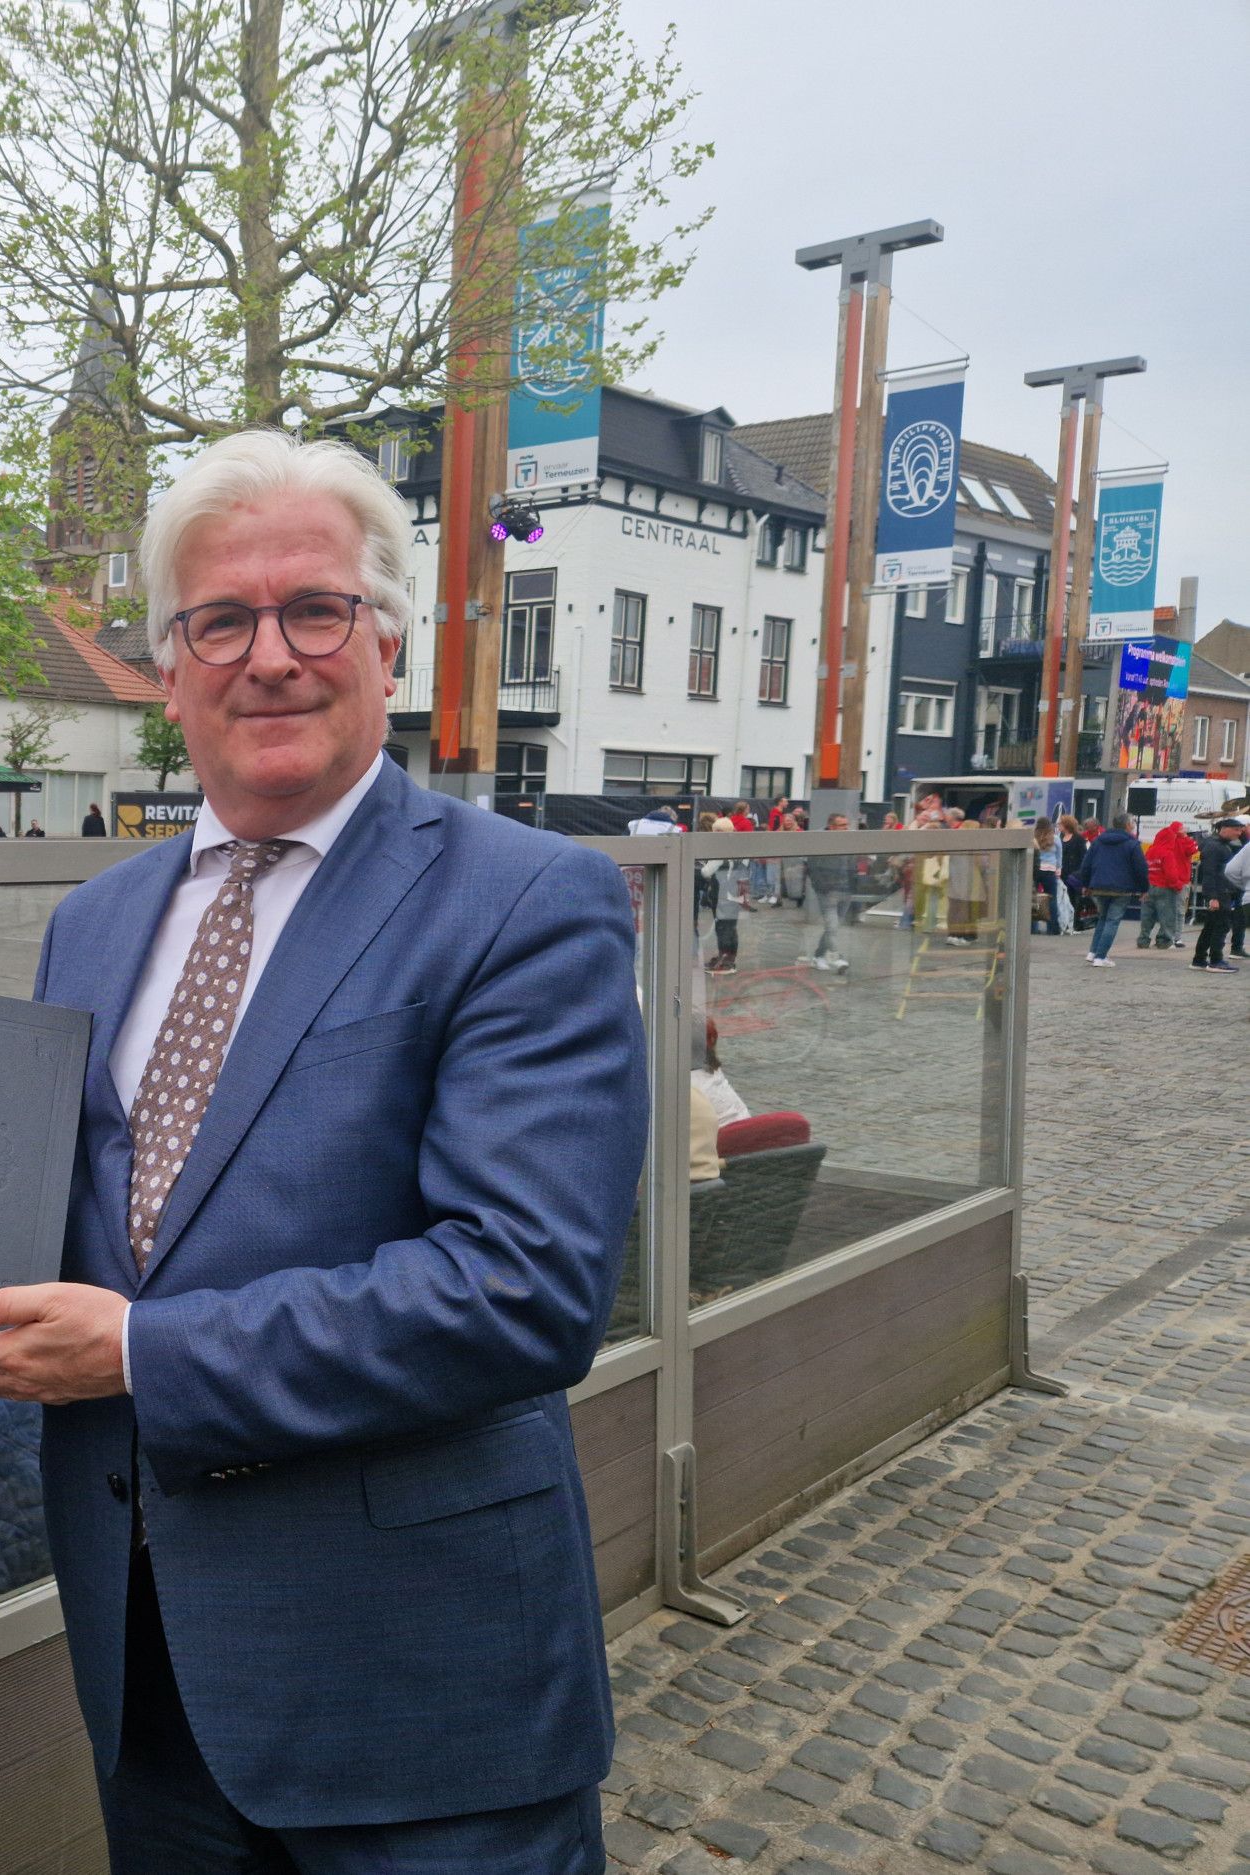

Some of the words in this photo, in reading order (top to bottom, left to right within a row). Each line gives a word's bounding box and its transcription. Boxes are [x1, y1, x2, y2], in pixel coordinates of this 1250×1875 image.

[893, 424, 950, 452] PHILIPPINE
[544, 466, 590, 479] Terneuzen
[621, 515, 722, 556] CENTRAAL
